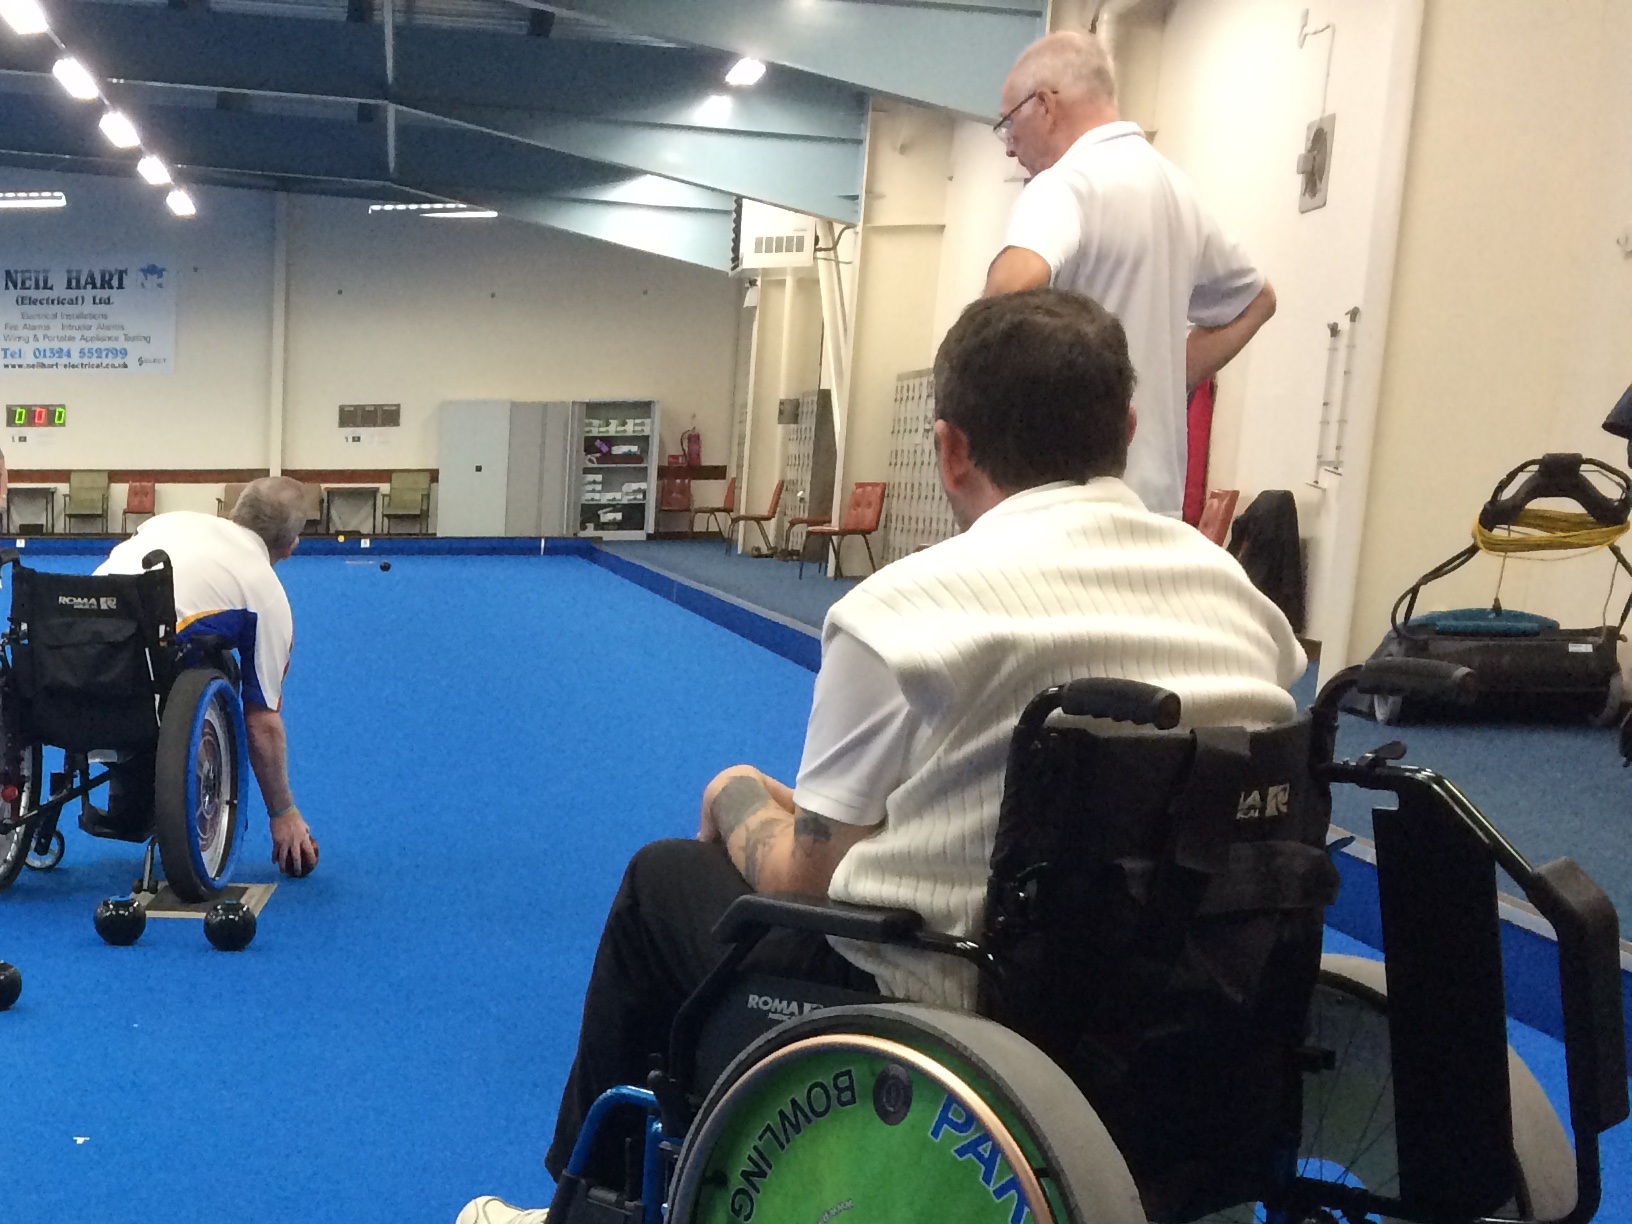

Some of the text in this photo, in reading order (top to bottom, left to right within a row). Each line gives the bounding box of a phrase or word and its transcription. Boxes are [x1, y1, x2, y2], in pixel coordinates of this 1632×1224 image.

[4, 267, 128, 291] NEIL HART
[15, 295, 115, 306] (Electrical) Ltd.
[32, 347, 72, 359] 01324
[14, 407, 65, 424] 0 0 0
[747, 993, 799, 1016] ROMA
[730, 1067, 858, 1224] BOWLING
